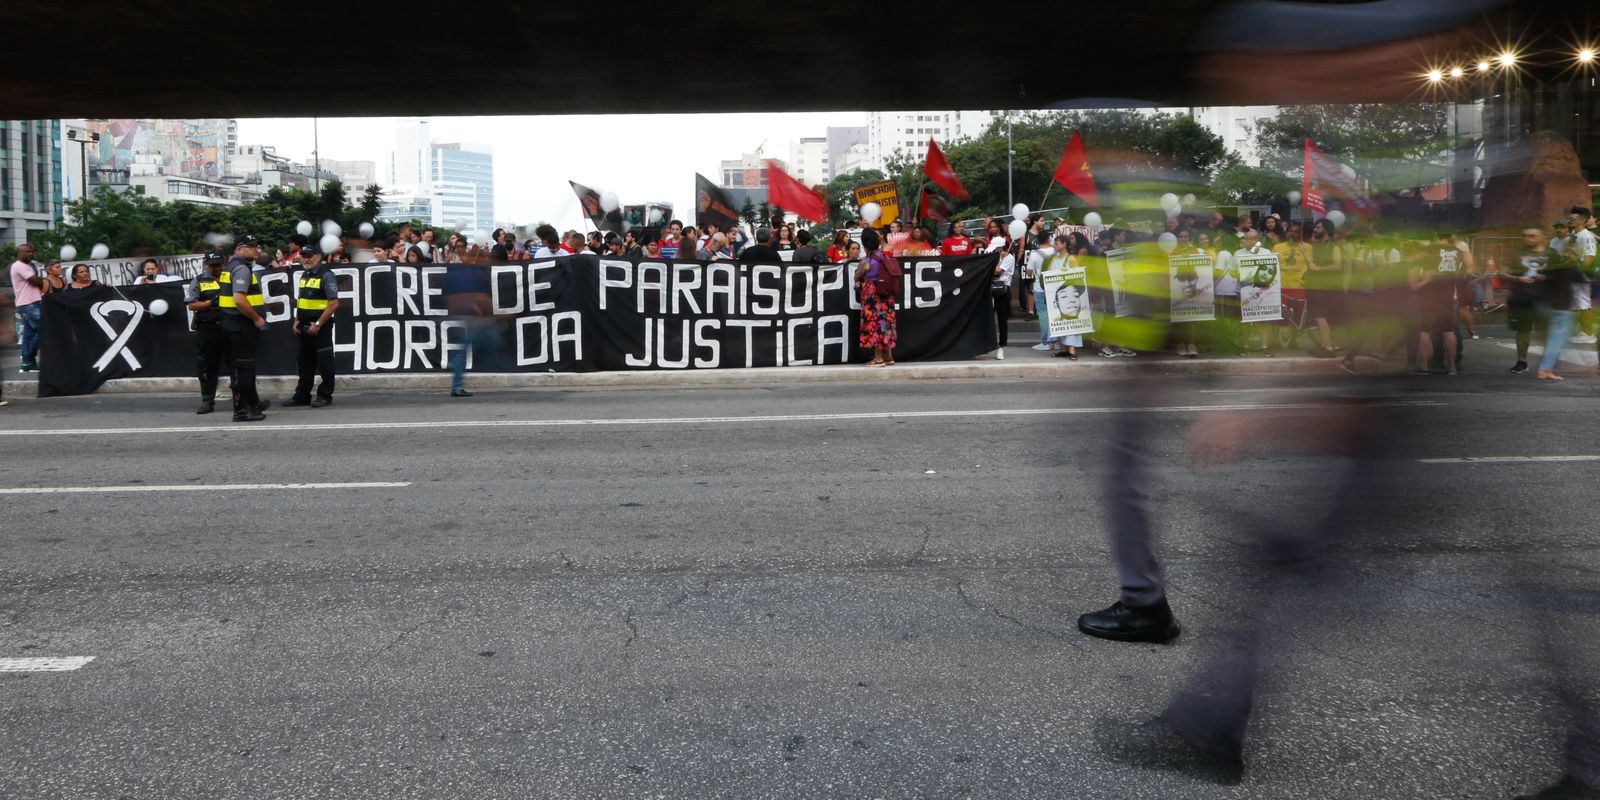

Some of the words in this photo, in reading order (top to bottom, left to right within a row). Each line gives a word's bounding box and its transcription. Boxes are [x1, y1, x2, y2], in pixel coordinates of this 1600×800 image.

[858, 184, 896, 198] BANCADA
[491, 260, 556, 315] DE
[332, 320, 473, 371] HORA
[516, 311, 583, 367] DA
